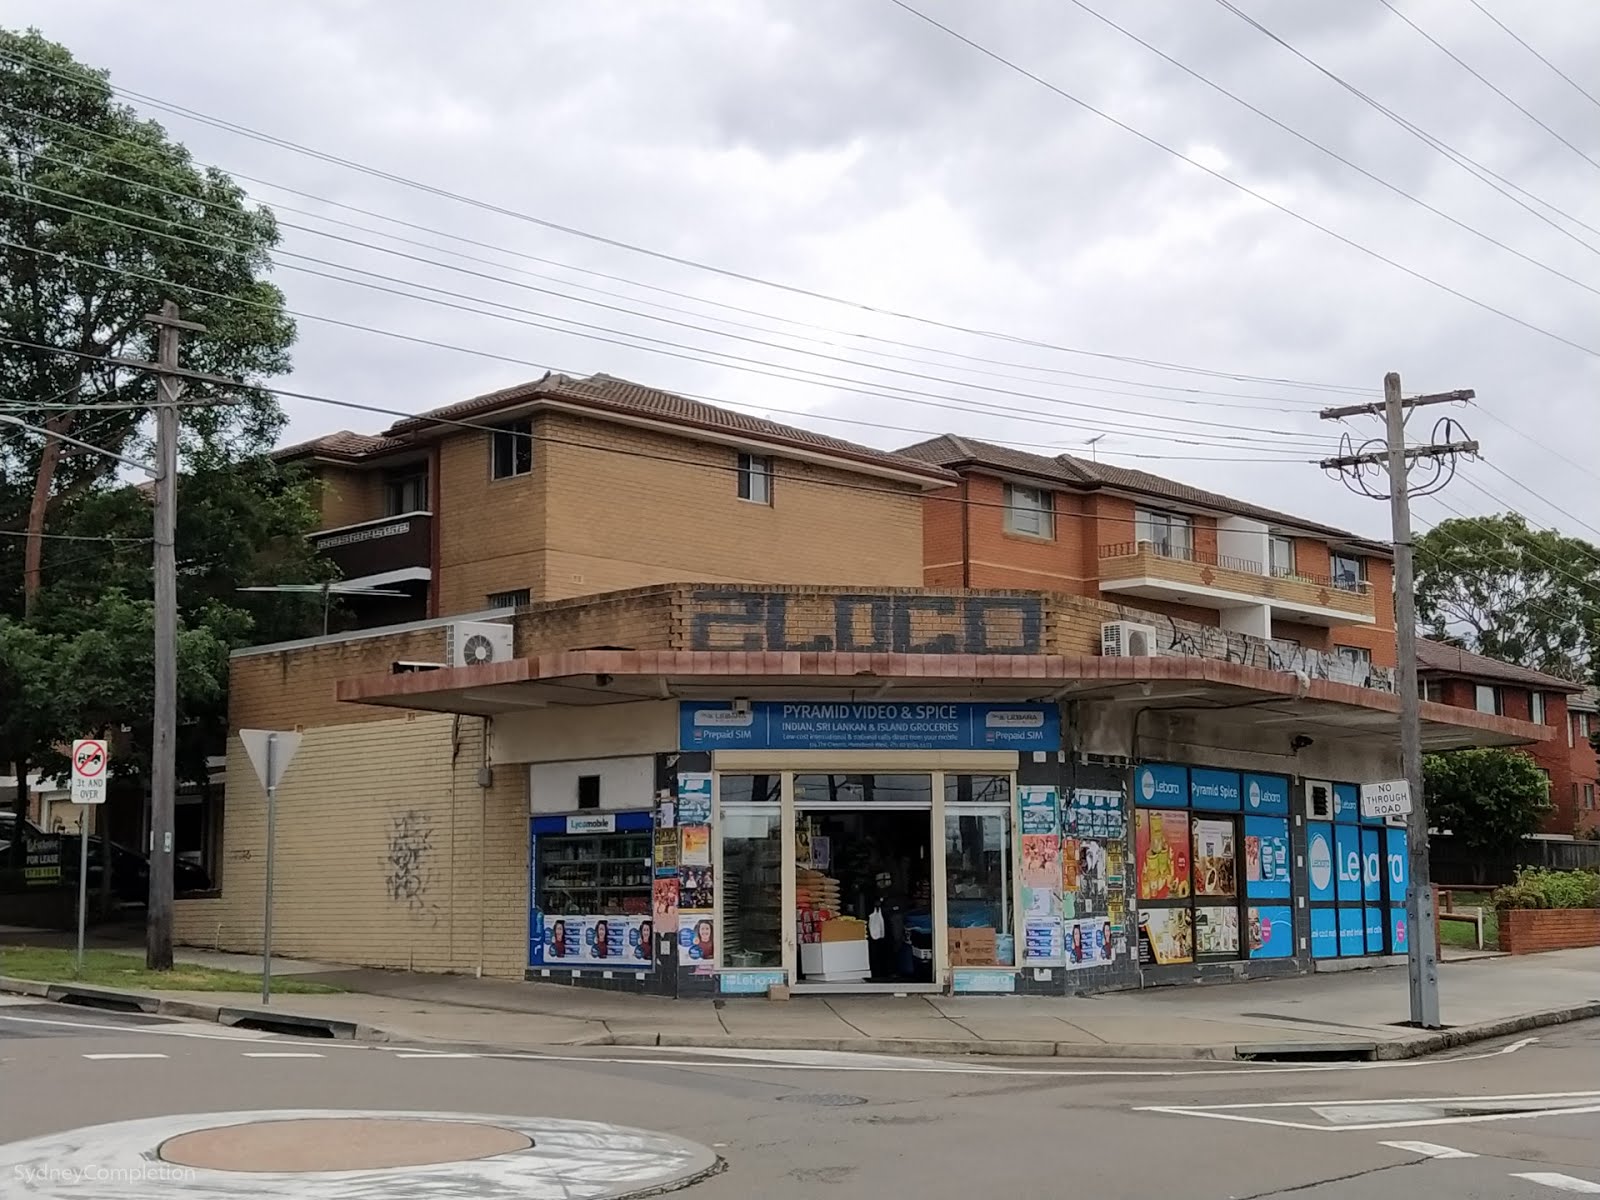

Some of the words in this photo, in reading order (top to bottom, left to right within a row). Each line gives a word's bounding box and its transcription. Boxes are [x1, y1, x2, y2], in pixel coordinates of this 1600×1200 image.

[783, 705, 847, 719] PYRAMID
[852, 705, 896, 719] VIDEO
[901, 705, 912, 720] &
[916, 706, 957, 720] SPICE
[782, 722, 814, 732] INDIAN,
[816, 722, 831, 732] SRI
[832, 722, 866, 732] LANKAN
[877, 723, 908, 732] ISLAND
[910, 722, 959, 732] GROCERIES
[703, 730, 734, 740] Prepaid
[735, 730, 752, 739] SIM
[995, 731, 1026, 741] Prepaid
[1027, 731, 1044, 740] SIM
[1155, 780, 1180, 794] Lebara
[1191, 782, 1218, 797] Pyramid
[1219, 785, 1238, 800] Spice
[1378, 784, 1392, 792] NO
[80, 790, 98, 799] OVER
[1260, 790, 1281, 803] Lebara
[1366, 793, 1407, 804] THROUGH
[1374, 804, 1401, 814] ROAD
[1338, 842, 1403, 883] Leaa
